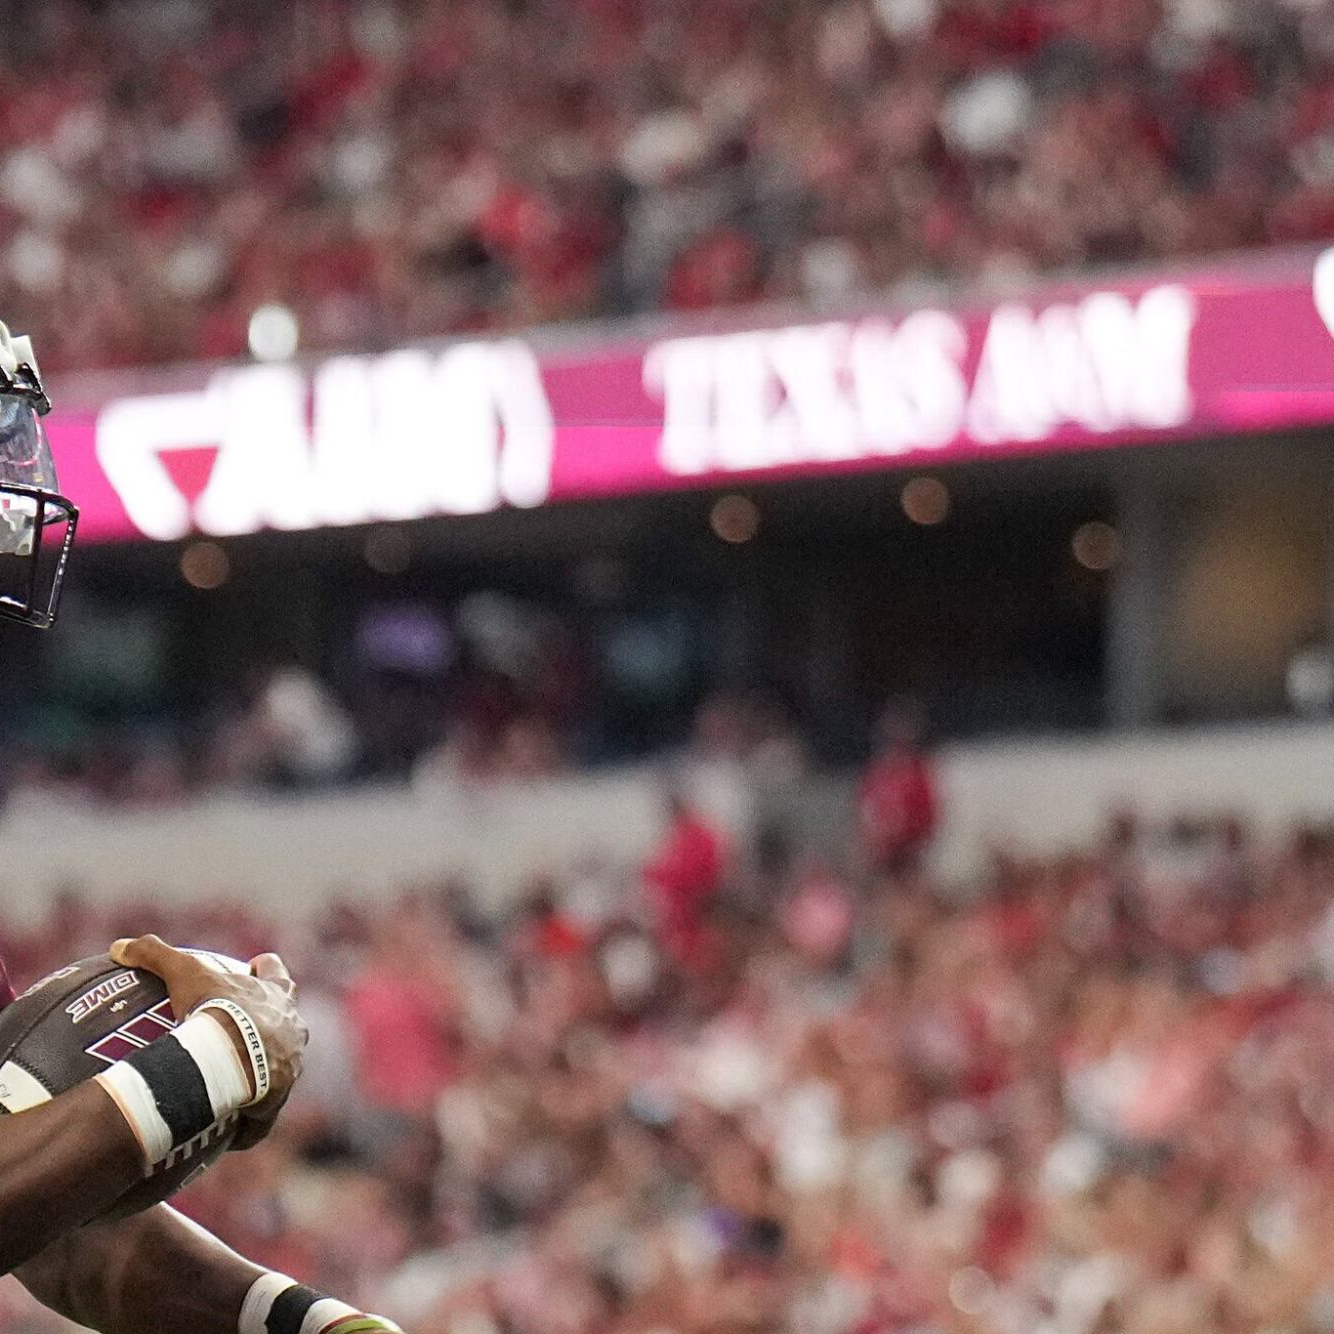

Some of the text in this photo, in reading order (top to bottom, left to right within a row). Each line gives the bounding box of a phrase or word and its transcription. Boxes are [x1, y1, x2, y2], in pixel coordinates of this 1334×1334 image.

[65, 970, 140, 1024] DIME
[227, 1004, 268, 1088] BETTER BEST
